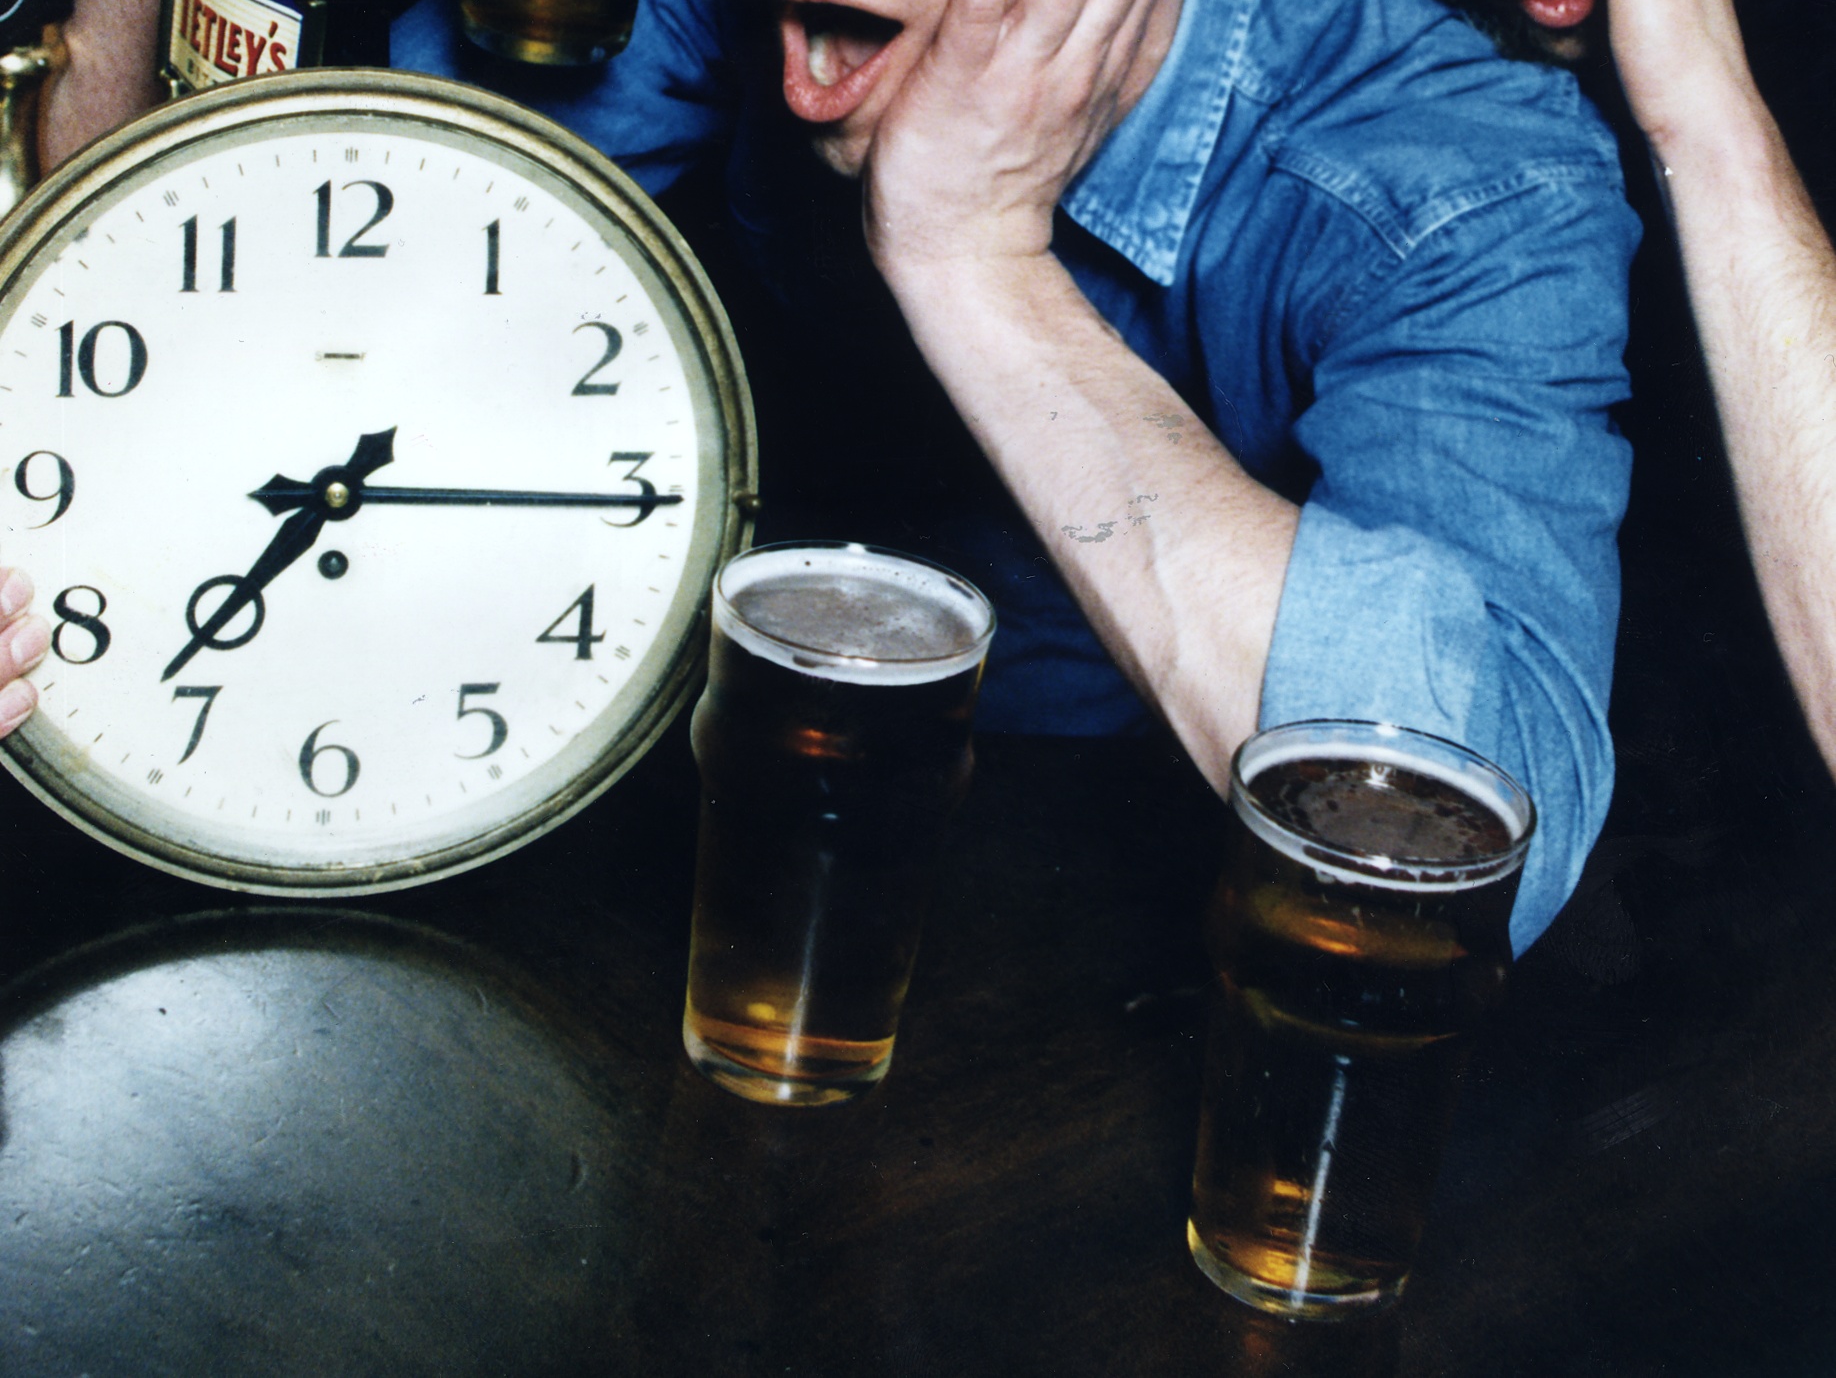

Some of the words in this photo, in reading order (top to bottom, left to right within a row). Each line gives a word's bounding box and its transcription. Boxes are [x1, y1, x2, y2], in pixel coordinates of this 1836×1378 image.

[178, 215, 237, 293] 11
[312, 179, 396, 258] 12
[481, 217, 502, 295] 1
[56, 319, 149, 398] 10
[570, 321, 625, 397] 2
[13, 450, 76, 529] 9
[600, 451, 657, 528] 3
[50, 585, 111, 665] 8
[536, 584, 606, 661] 4
[170, 685, 222, 764] 7
[298, 719, 361, 797] 6
[453, 682, 509, 760] 5
